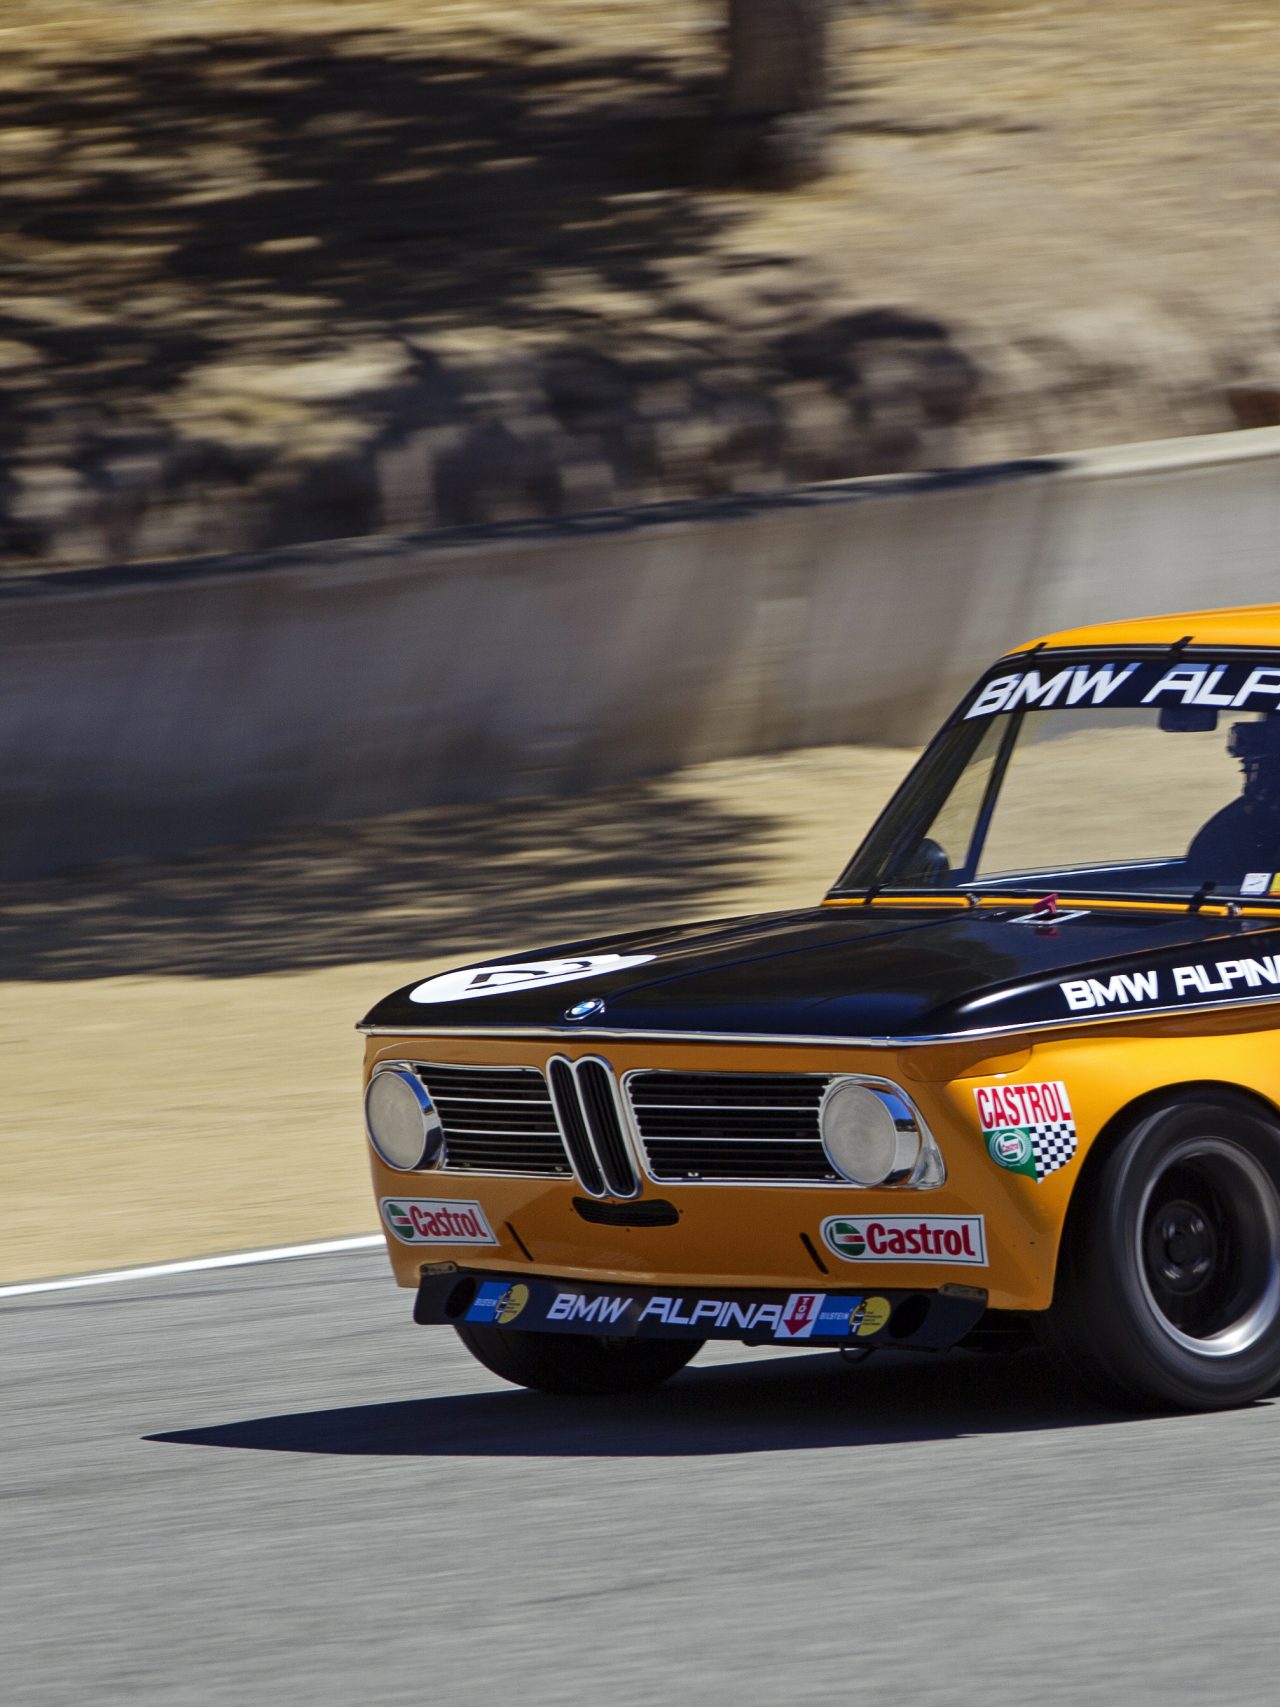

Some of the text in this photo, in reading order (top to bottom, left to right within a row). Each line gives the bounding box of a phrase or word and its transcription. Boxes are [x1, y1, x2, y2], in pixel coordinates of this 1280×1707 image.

[964, 662, 1142, 720] BMW
[1060, 970, 1158, 1010] BMW
[977, 1083, 1072, 1129] CASTROL
[409, 1205, 488, 1238] Castrol
[866, 1223, 976, 1256] Castrol
[546, 1293, 633, 1323] BMW
[638, 1296, 783, 1330] ALPINA
[795, 1297, 810, 1320] TOW
